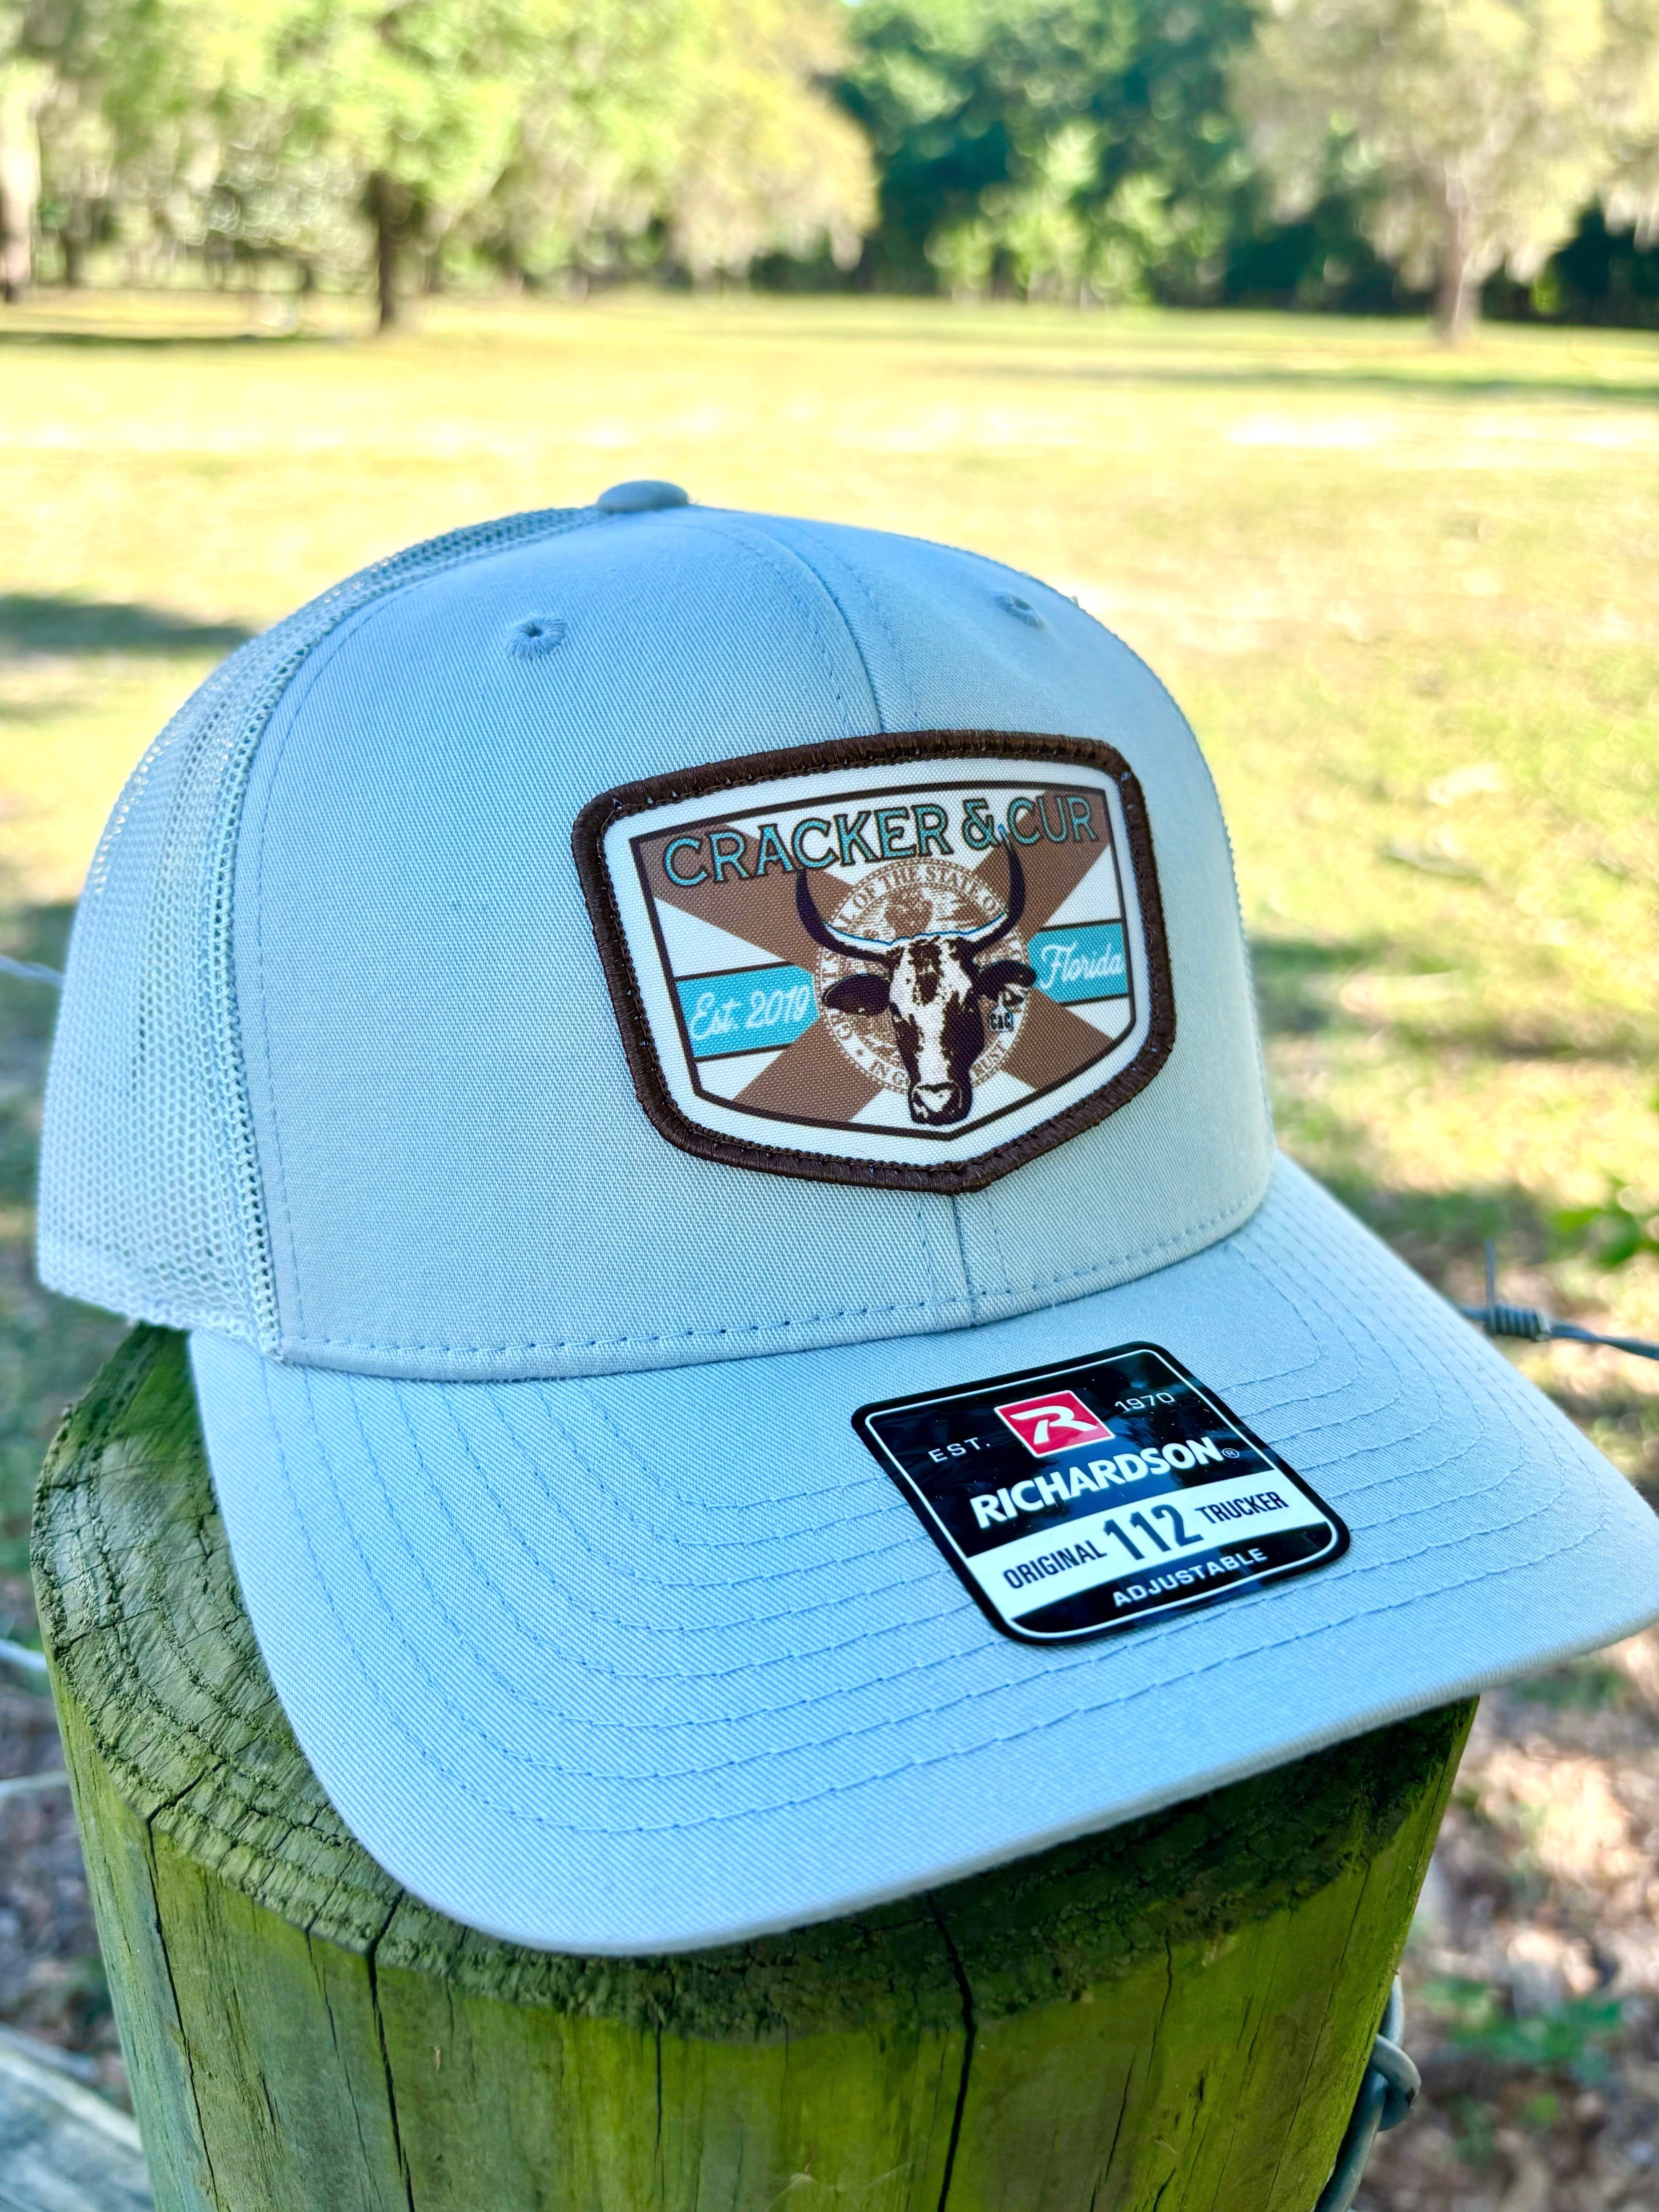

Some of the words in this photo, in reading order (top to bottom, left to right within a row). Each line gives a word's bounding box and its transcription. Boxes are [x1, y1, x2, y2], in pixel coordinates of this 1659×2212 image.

[663, 804, 954, 887] CRACKER
[962, 797, 1001, 851] &
[1007, 796, 1099, 845] CUR
[1040, 939, 1125, 989] Florida
[928, 1437, 991, 1463] EST.
[1114, 1392, 1176, 1413] 1970
[1003, 1539, 1108, 1590] ORIGINAL
[1103, 1503, 1205, 1561] 112
[1195, 1491, 1289, 1525] TRUCKER
[1113, 1547, 1269, 1607] ADJUSTABLE
